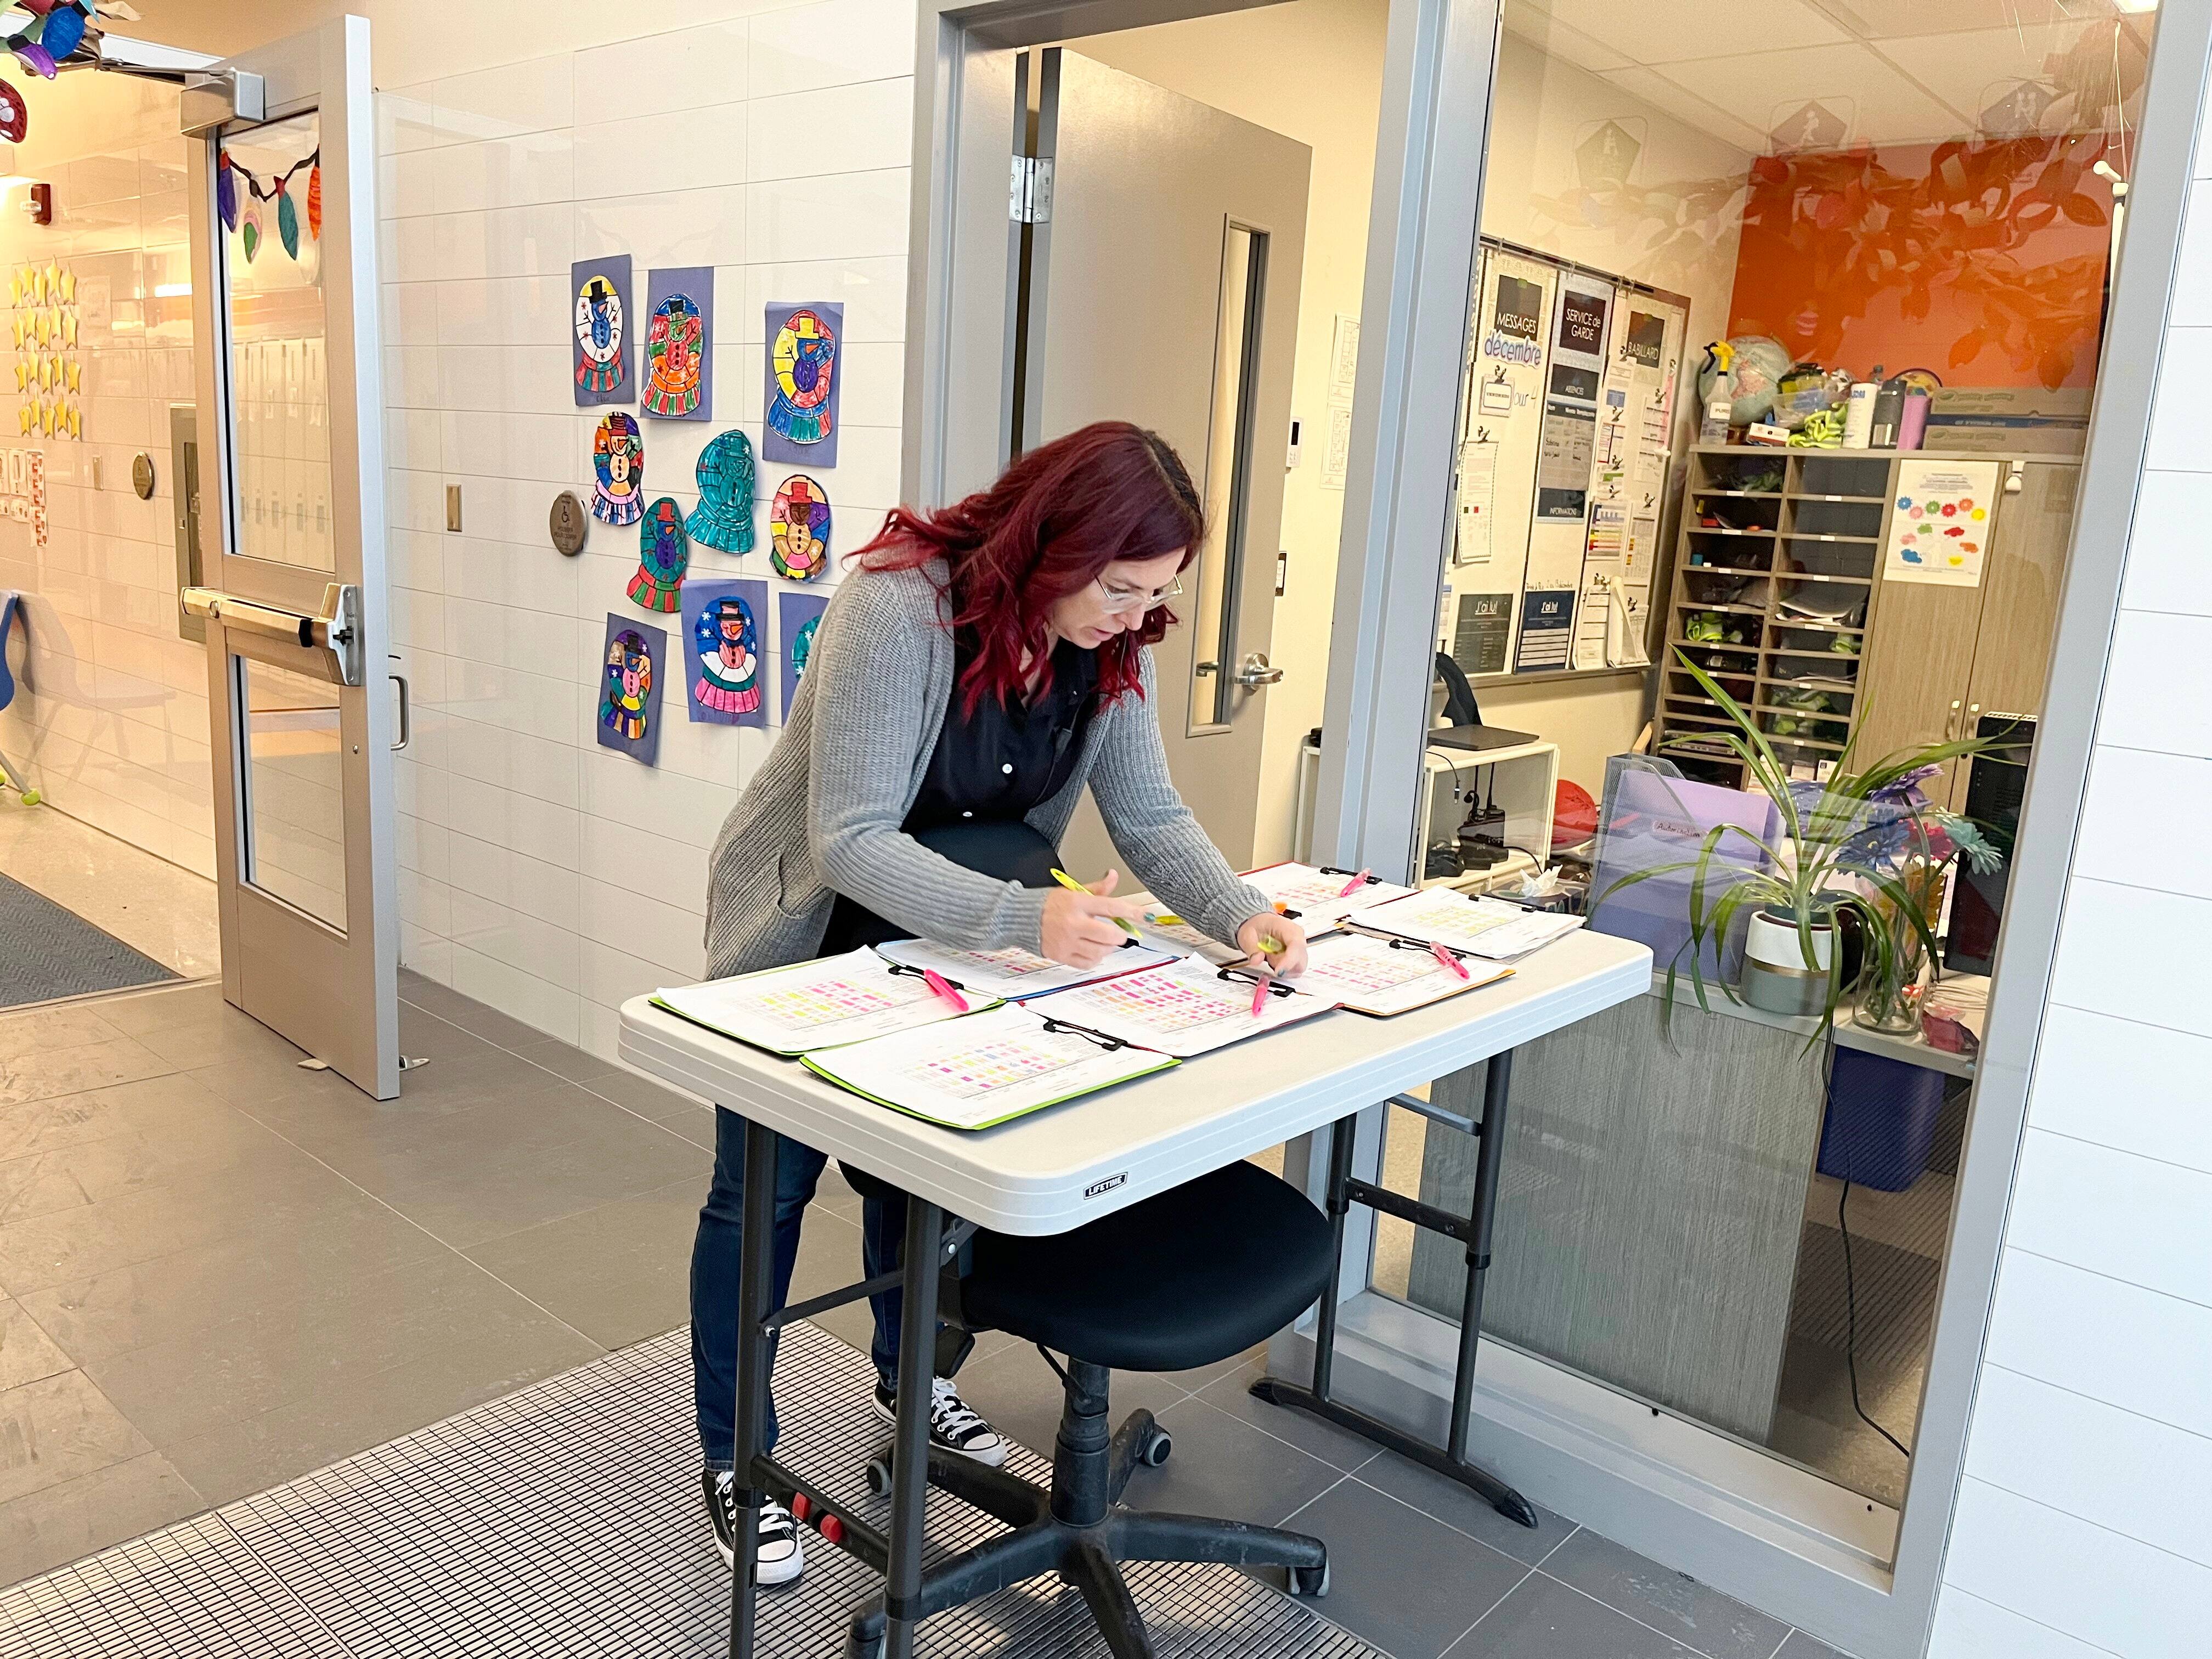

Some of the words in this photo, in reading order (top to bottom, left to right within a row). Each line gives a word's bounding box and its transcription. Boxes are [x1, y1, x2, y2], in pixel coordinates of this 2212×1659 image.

[1497, 312, 1537, 334] MESSAGES
[1566, 308, 1593, 326] SERVICE
[1592, 315, 1601, 328] de
[1571, 324, 1594, 341] GARDE
[1485, 331, 1541, 365] décembre
[1088, 1176, 1122, 1195] LIFETIME
